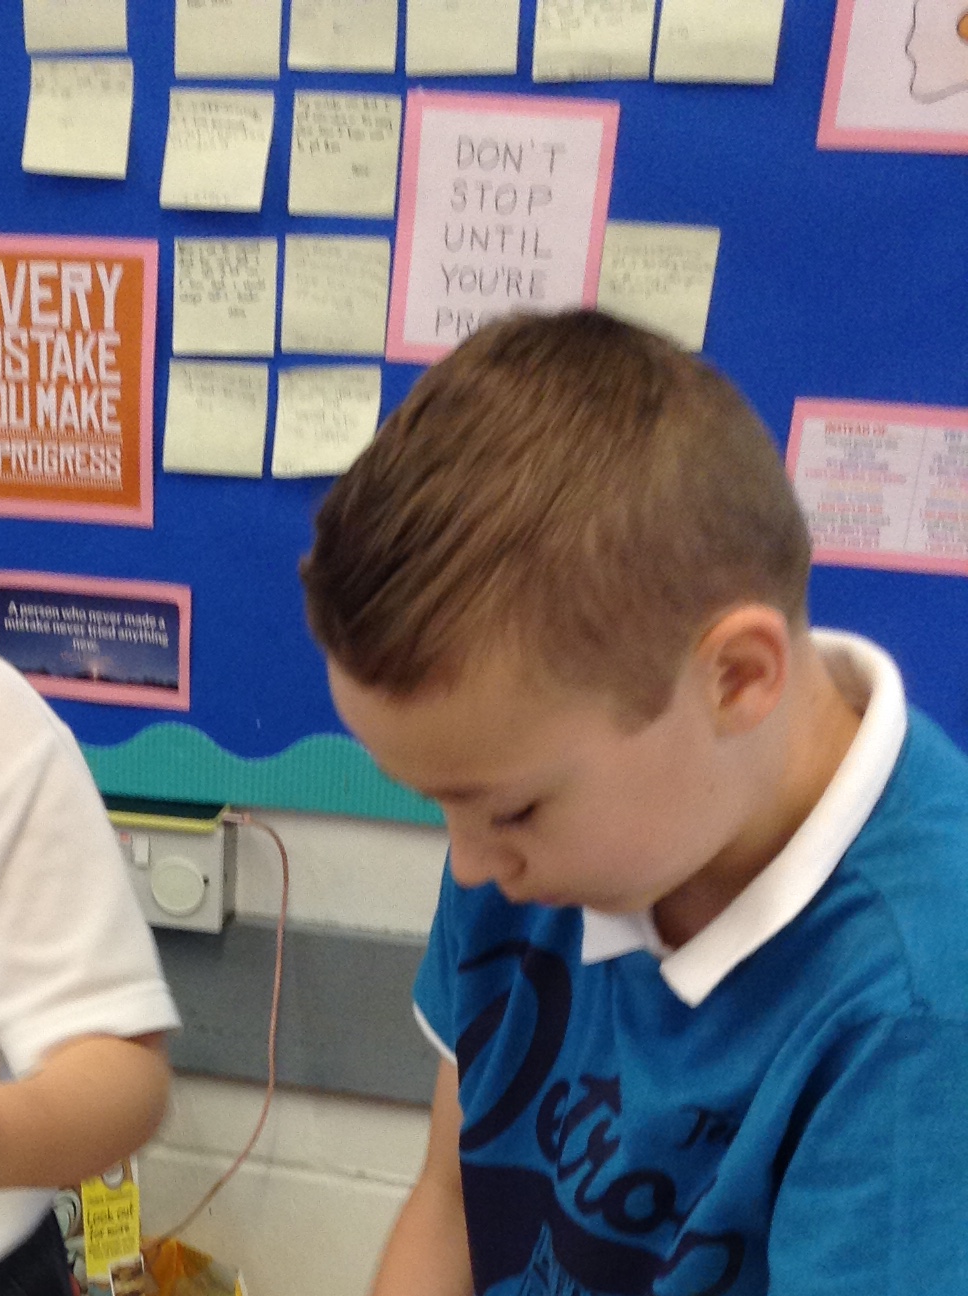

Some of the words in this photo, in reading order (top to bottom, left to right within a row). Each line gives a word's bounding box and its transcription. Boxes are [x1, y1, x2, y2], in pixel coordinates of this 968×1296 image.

[456, 134, 566, 175] DON'T
[450, 176, 553, 216] STOP
[443, 221, 553, 260] UNTIL
[441, 262, 547, 297] YOU'RE
[34, 382, 122, 436] MAKE
[8, 600, 18, 615] A
[20, 603, 60, 621] person
[61, 606, 87, 621] who
